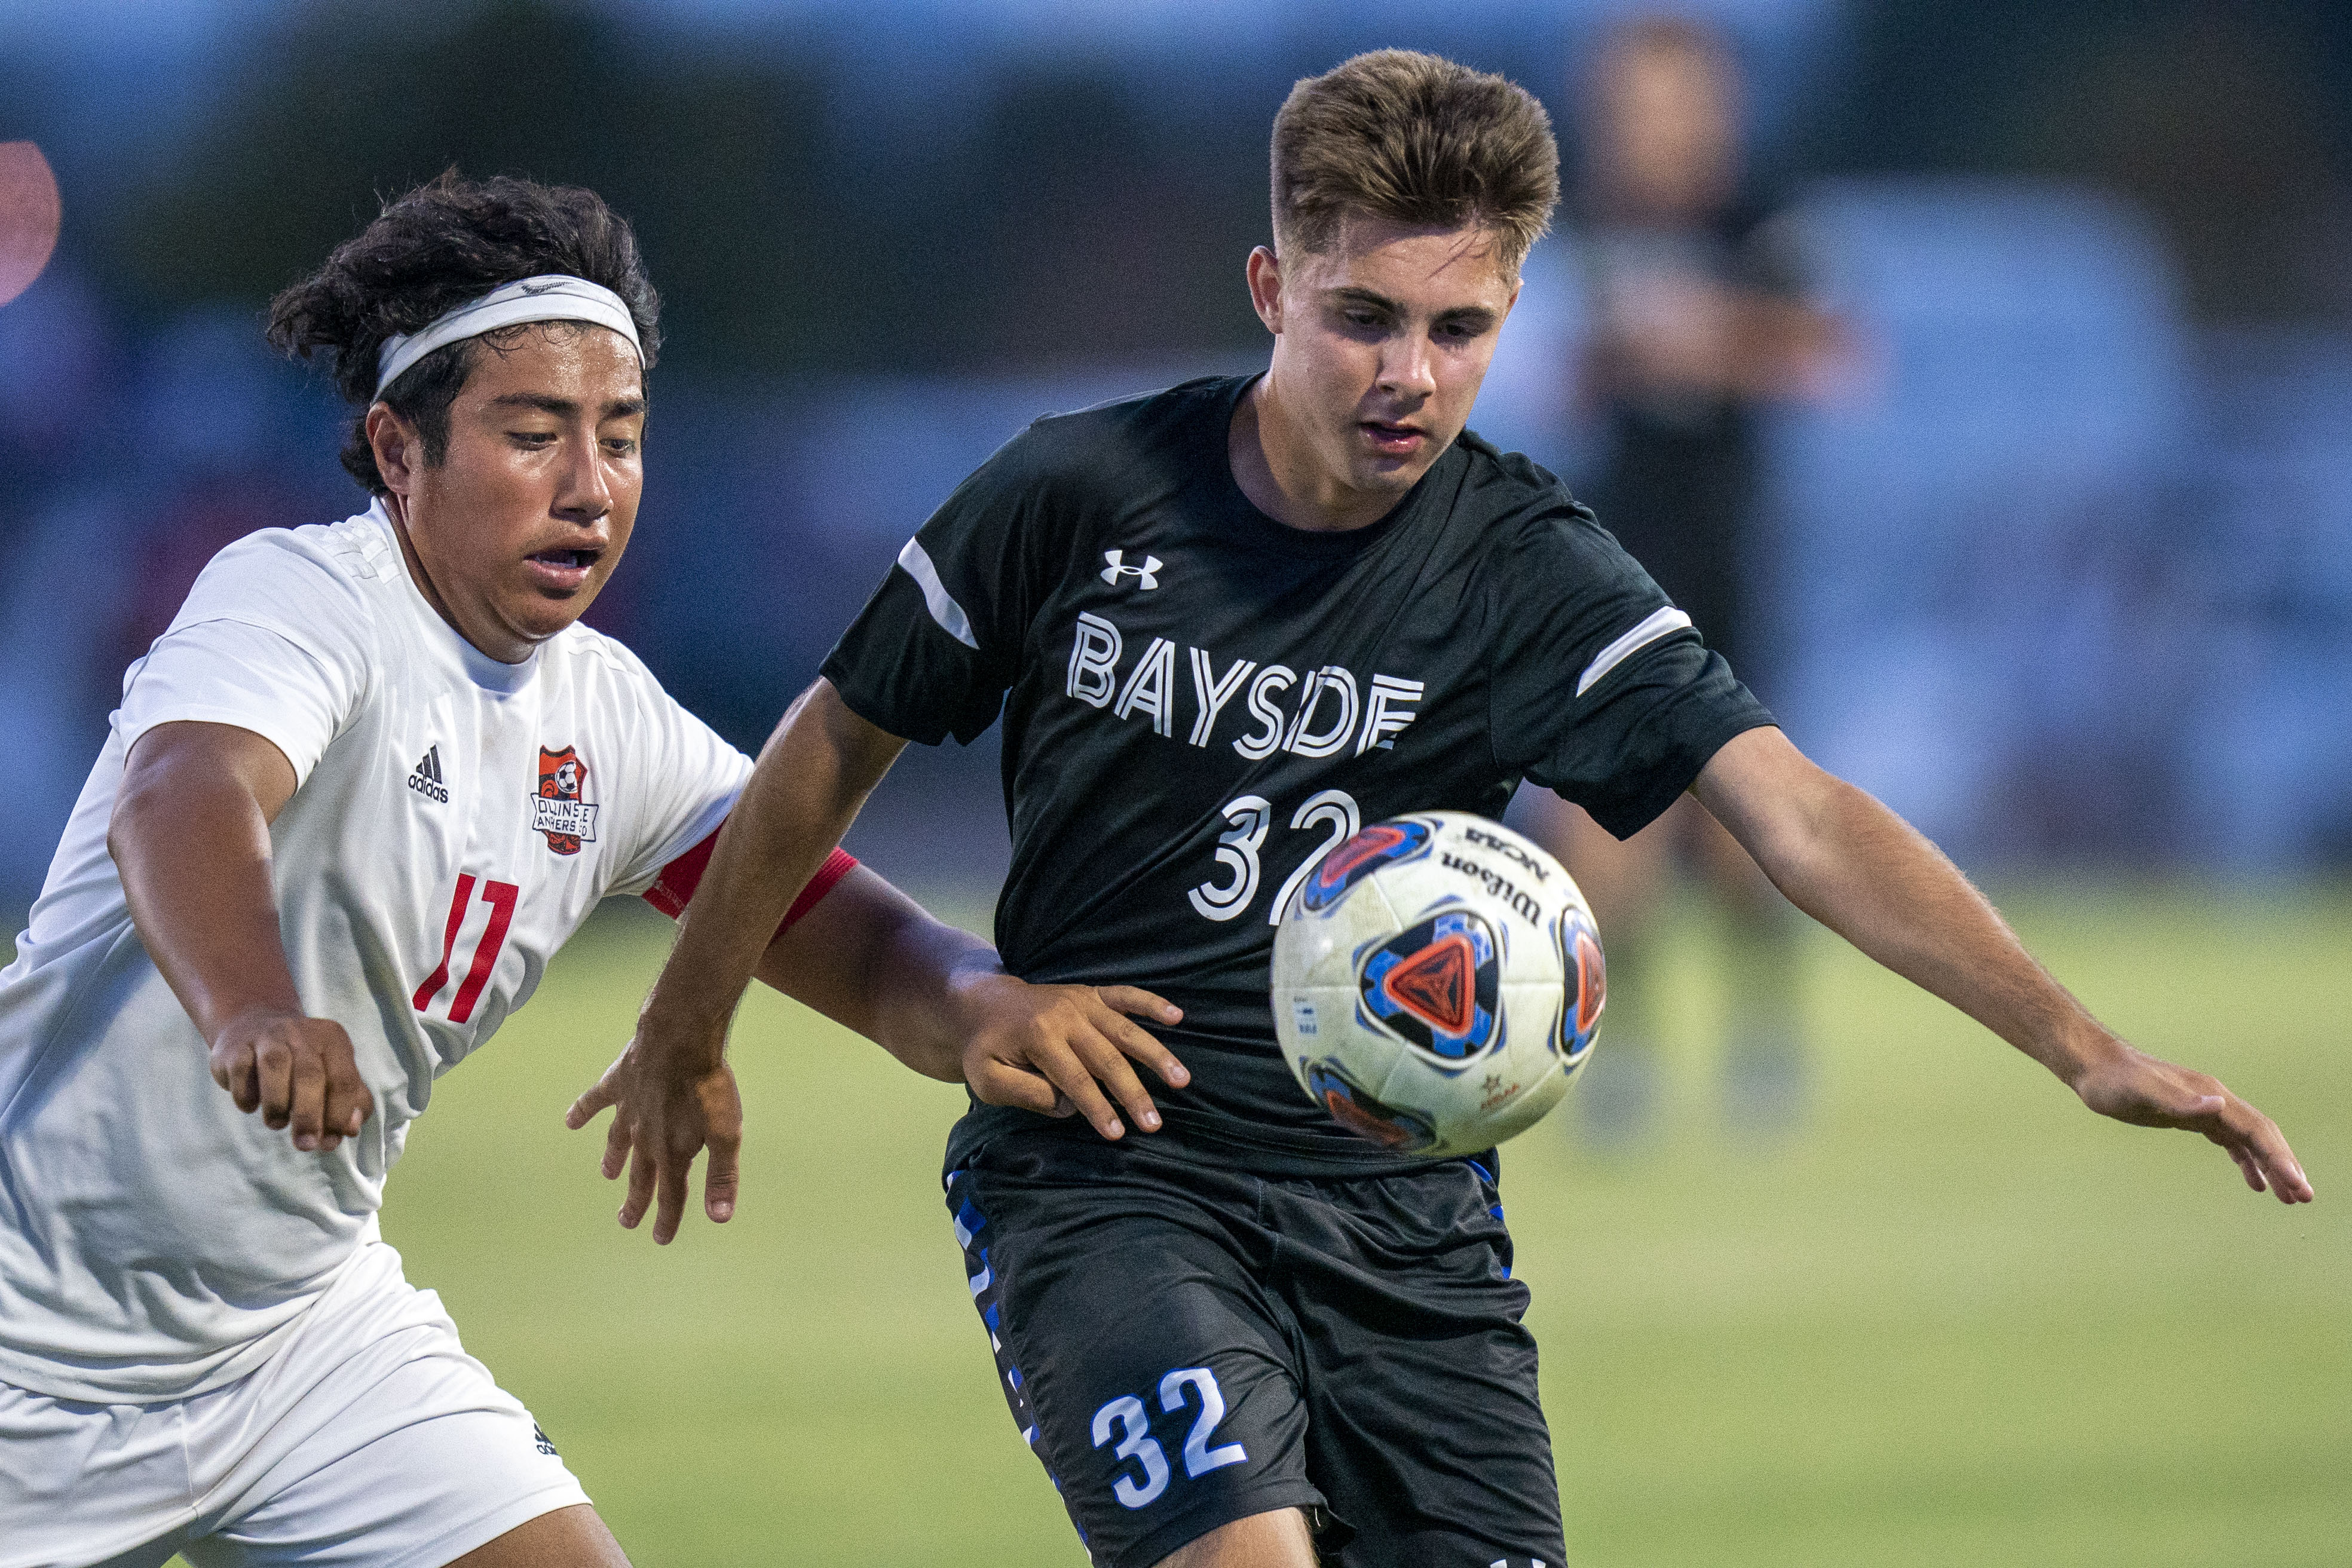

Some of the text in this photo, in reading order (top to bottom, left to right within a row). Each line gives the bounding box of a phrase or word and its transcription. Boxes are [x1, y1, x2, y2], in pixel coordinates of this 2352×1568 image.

[408, 773, 448, 804] adidas
[1188, 789, 1360, 926] 32
[1441, 851, 1542, 929] Wilson
[1465, 826, 1551, 883] NCAA
[412, 872, 519, 1024] 17
[1090, 1367, 1249, 1510] 32
